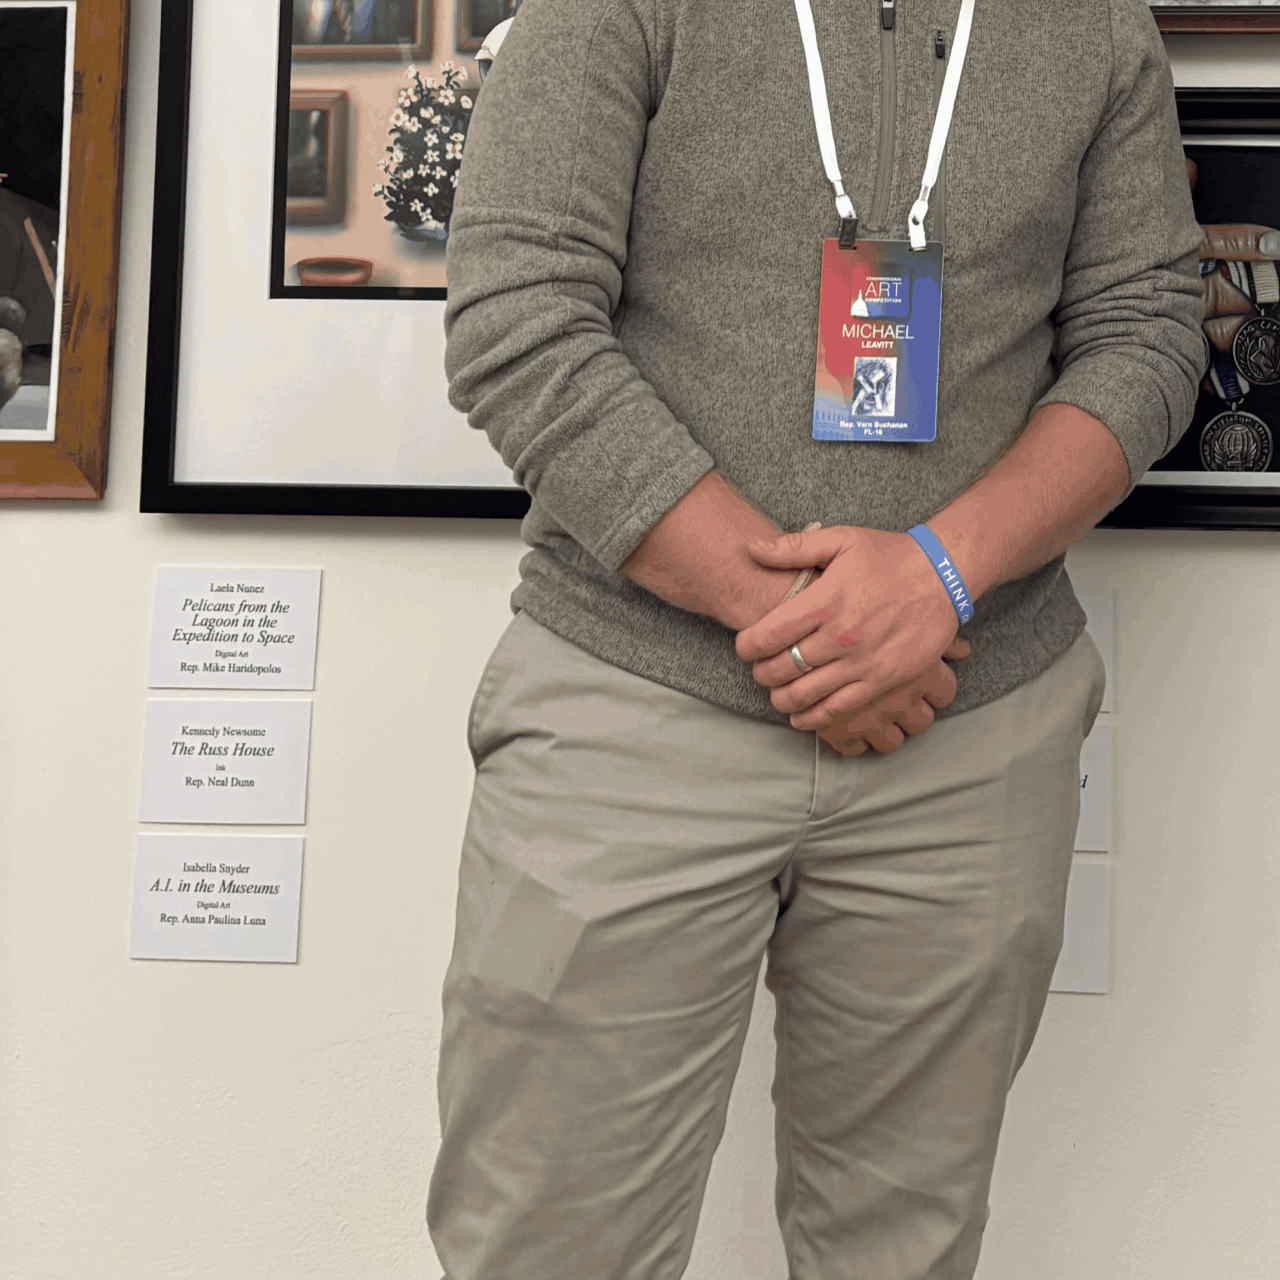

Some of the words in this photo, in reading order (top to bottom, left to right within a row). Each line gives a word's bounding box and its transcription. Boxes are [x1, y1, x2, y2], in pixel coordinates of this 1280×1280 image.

[865, 282, 902, 297] ART
[842, 324, 914, 339] MICHAEL
[862, 341, 894, 349] LEAVITT
[840, 420, 855, 429] Rep.
[874, 421, 908, 429] Buchanan
[210, 583, 234, 593] Laela
[237, 584, 264, 593] Nunez
[938, 557, 969, 612] THINK
[182, 599, 235, 612] Pelicans
[236, 600, 267, 615] from
[271, 600, 290, 613] the
[191, 614, 238, 630] Lagoon
[242, 616, 254, 627] in
[258, 616, 278, 628] the
[172, 629, 238, 645] Expedition
[242, 631, 254, 643] to
[257, 631, 295, 645] Space
[215, 650, 237, 658] Digital
[180, 663, 200, 673] Rep.
[203, 663, 225, 672] Mike
[228, 663, 282, 675] Haridopolos
[181, 726, 220, 738] Kennedy
[223, 727, 266, 736] Newsome
[171, 742, 194, 755] The
[198, 742, 229, 756] Russ
[232, 742, 275, 756] House
[185, 777, 205, 788] Rep.
[208, 777, 228, 787] Neal
[231, 778, 255, 787] Dunn
[183, 862, 217, 872] Isabella
[219, 863, 250, 875] Snyder
[150, 878, 172, 892] A.I.
[178, 879, 191, 892] in
[194, 879, 215, 893] the
[218, 880, 280, 894] Museums
[197, 901, 218, 910] Digital
[160, 913, 180, 925] Rep.
[182, 914, 206, 924] Anna
[208, 915, 241, 925] Paulina
[243, 915, 266, 925] Luna
